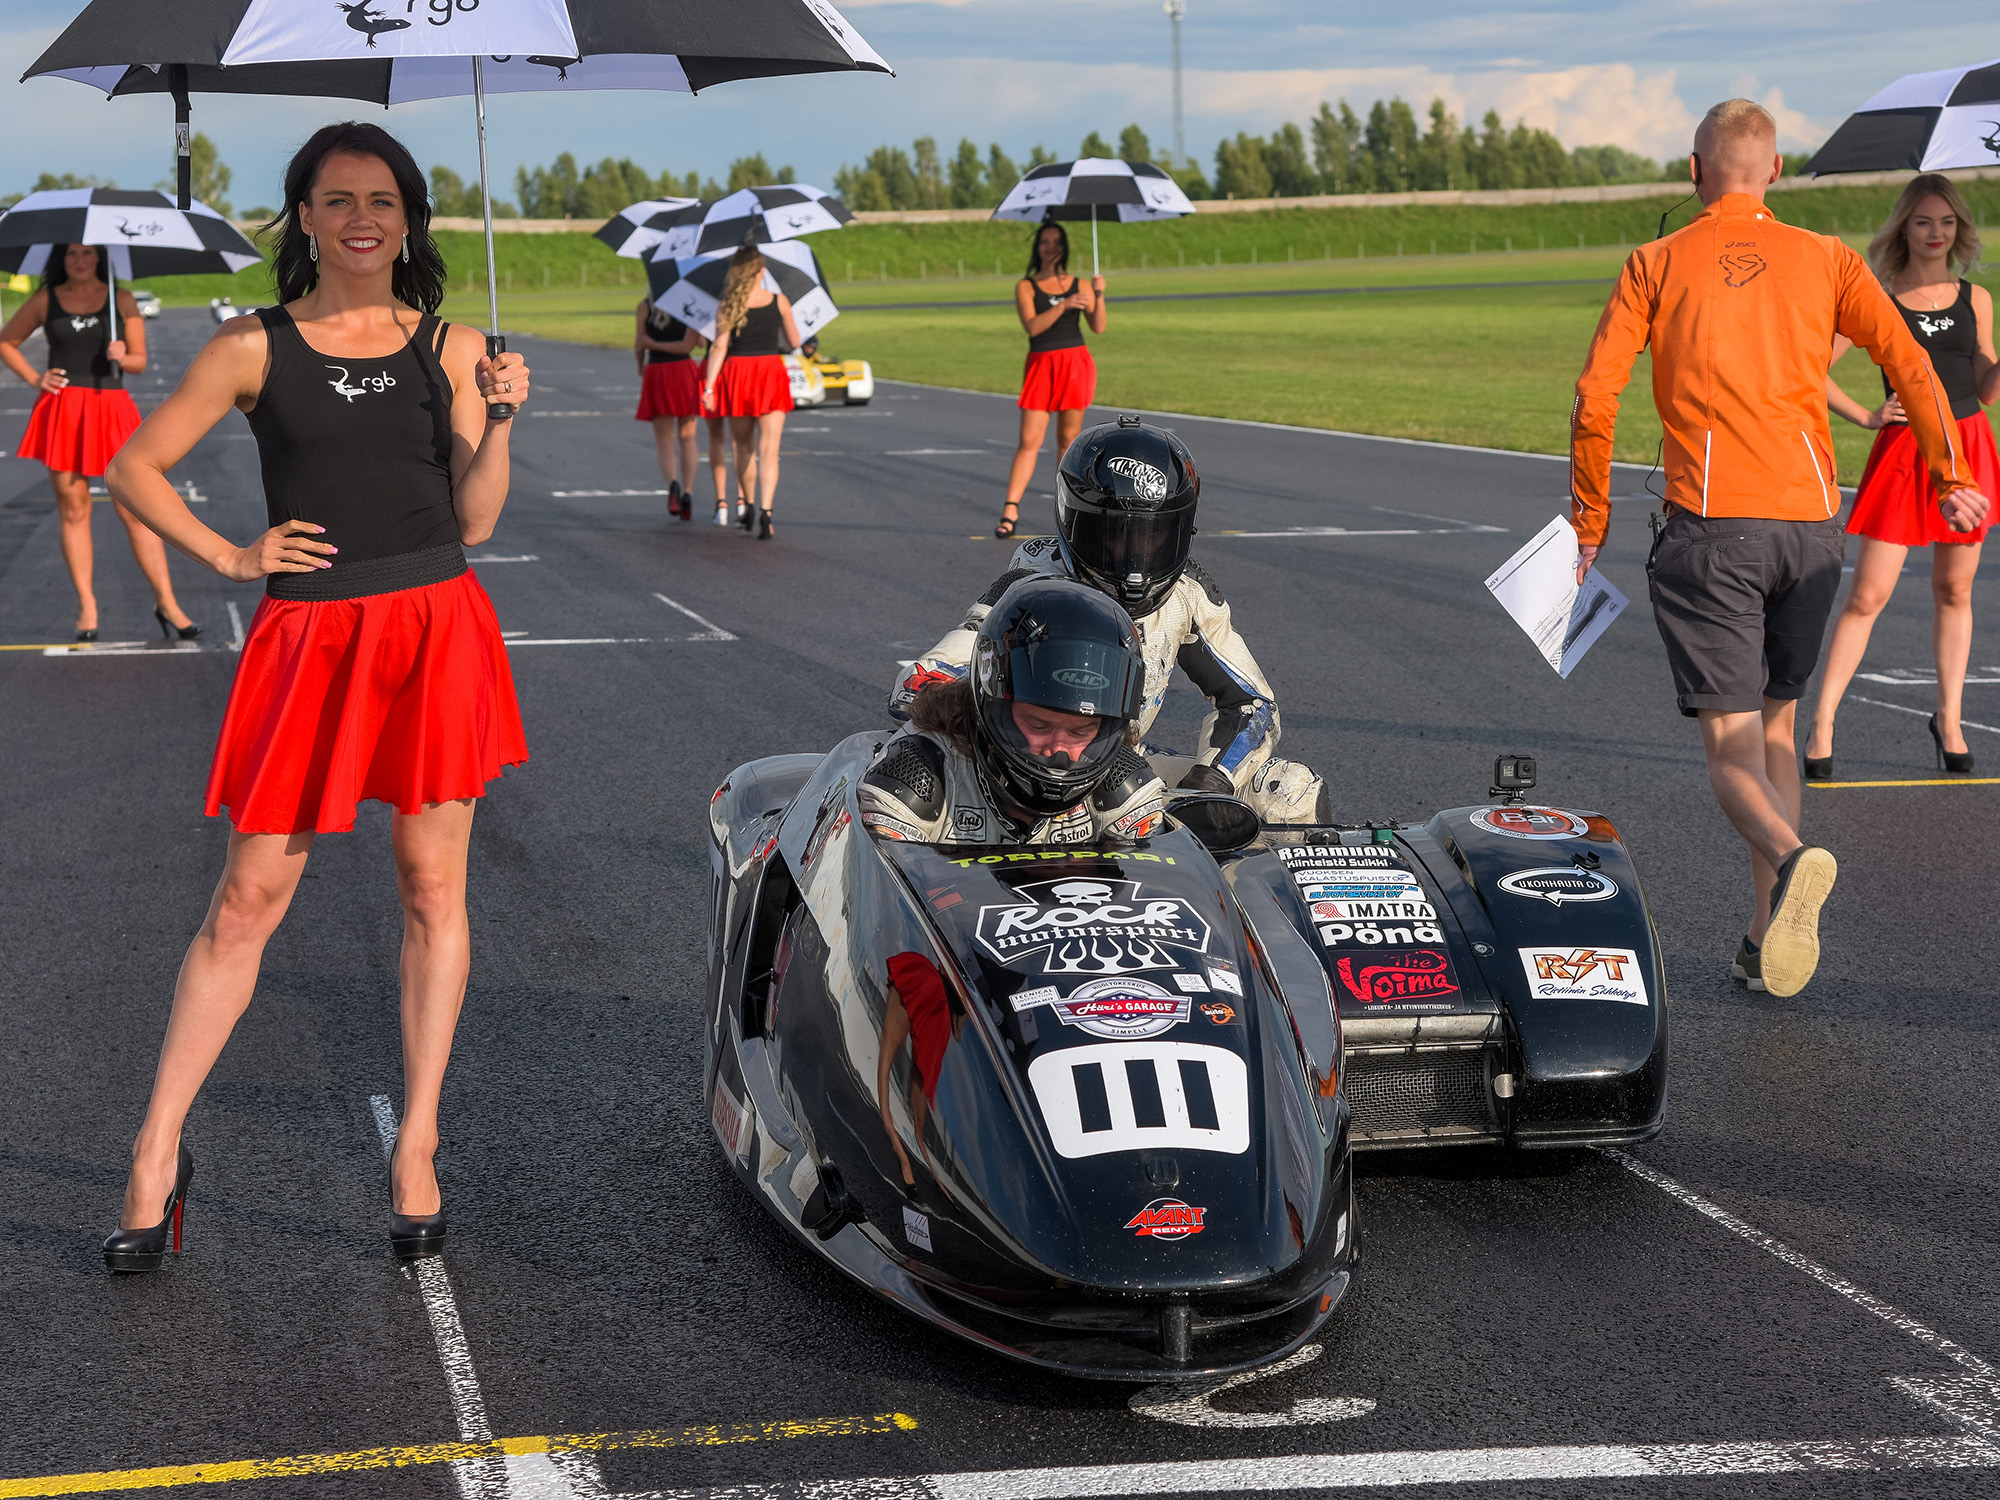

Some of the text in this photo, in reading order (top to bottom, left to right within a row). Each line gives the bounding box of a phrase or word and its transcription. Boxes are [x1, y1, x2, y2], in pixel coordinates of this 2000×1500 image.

[1934, 316, 1955, 330] rgb
[361, 370, 396, 392] rgb
[1061, 671, 1100, 686] HJC
[959, 811, 981, 827] Arai
[1500, 812, 1558, 824] Bar
[947, 851, 1176, 868] TORPPARI
[1518, 880, 1601, 889] UKONHAUTA OY
[1347, 903, 1432, 918] IMATRA
[996, 924, 1200, 949] motorsport
[1319, 922, 1445, 946] Pönä
[1337, 956, 1458, 1003] Voima
[1014, 988, 1054, 1000] TECNICAL
[1125, 1002, 1173, 1011] GARAGE
[1124, 1207, 1203, 1229] AVANT
